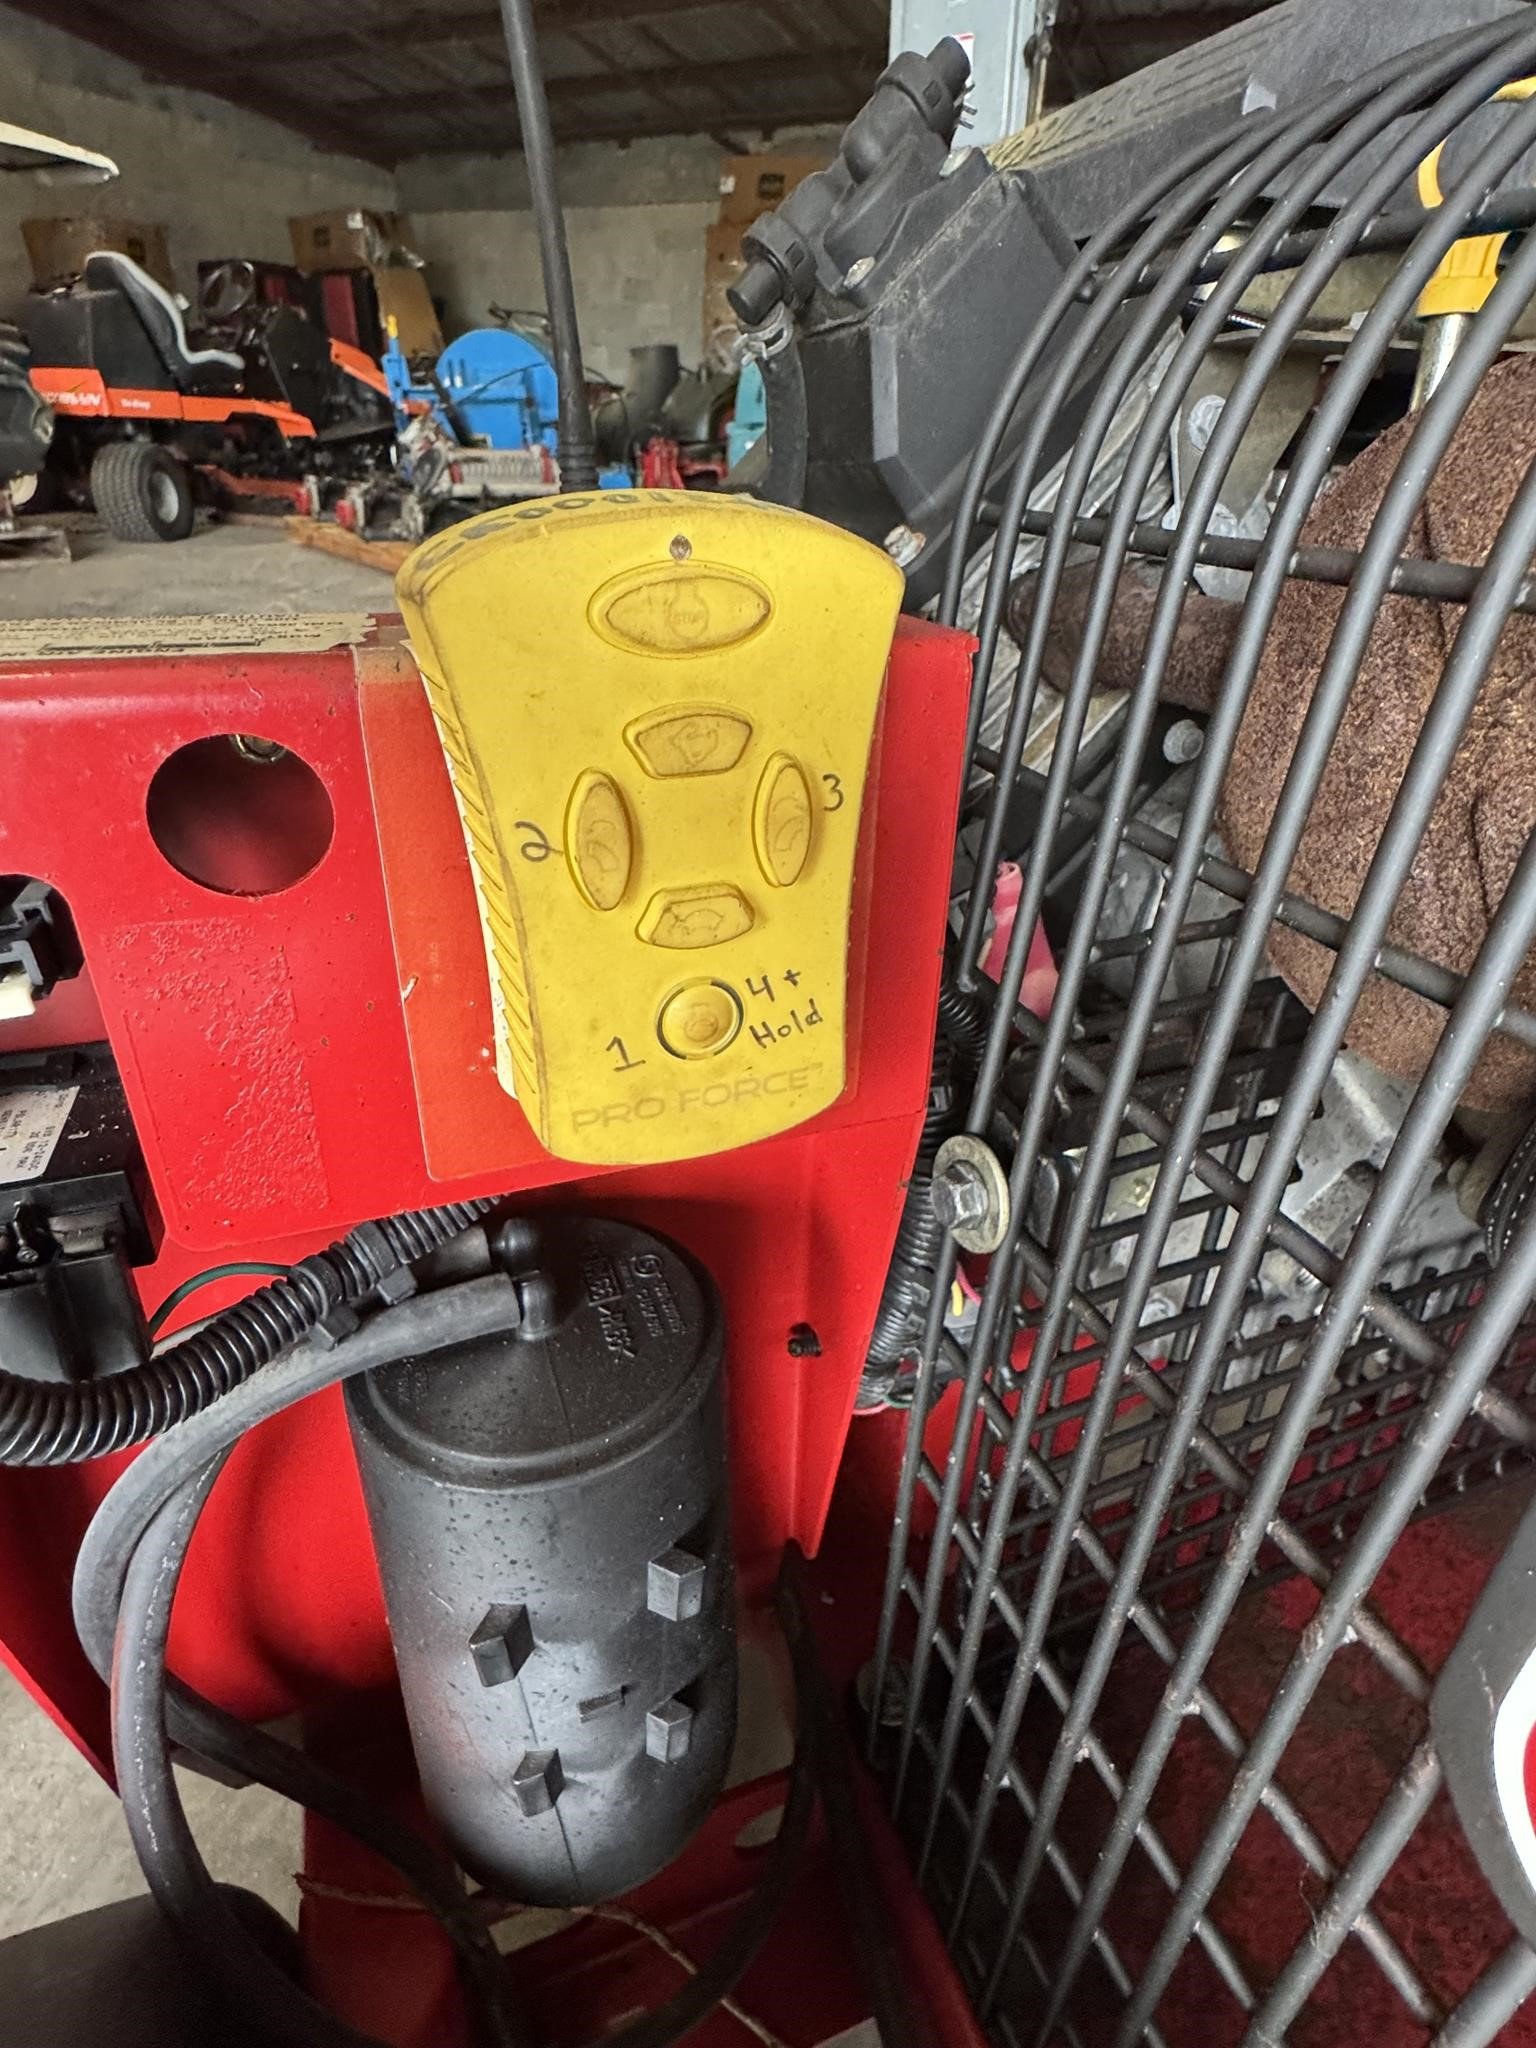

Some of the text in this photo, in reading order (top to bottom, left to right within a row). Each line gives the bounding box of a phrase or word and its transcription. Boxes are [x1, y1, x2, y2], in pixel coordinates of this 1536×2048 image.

[822, 774, 844, 811] 3
[514, 820, 564, 863] 2
[745, 974, 776, 1003] 4
[748, 997, 823, 1049] Hold
[605, 1035, 647, 1073] 1
[572, 1096, 666, 1133] PRO
